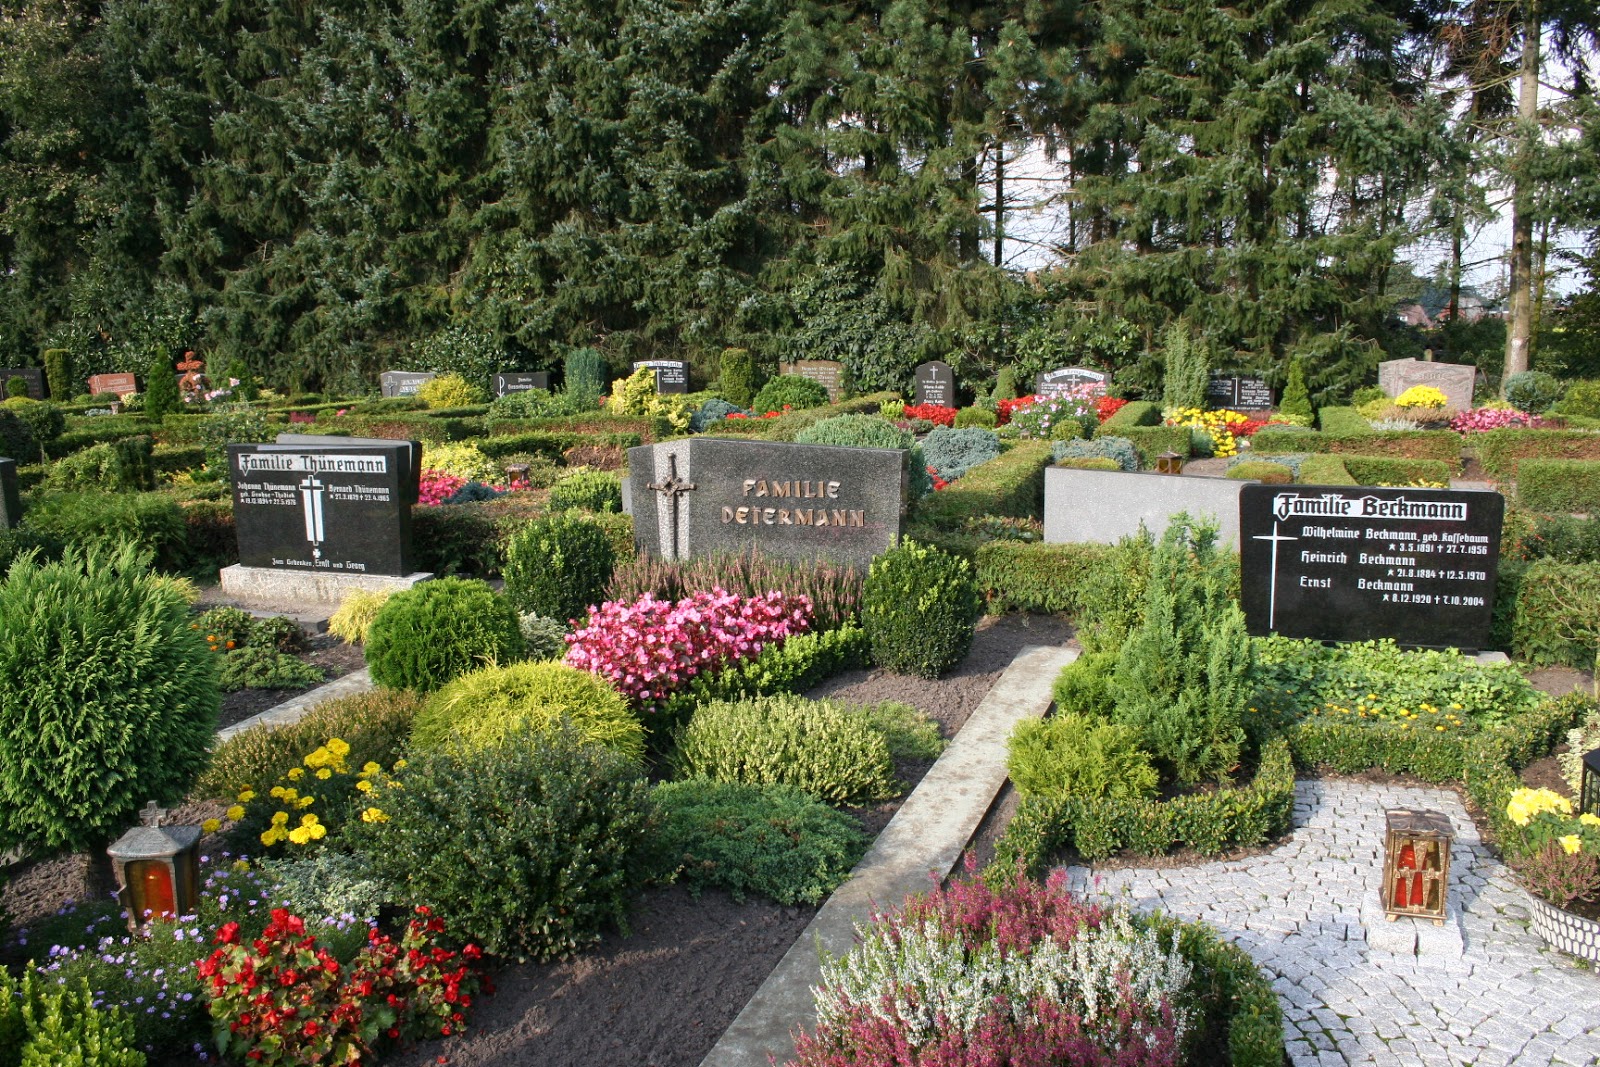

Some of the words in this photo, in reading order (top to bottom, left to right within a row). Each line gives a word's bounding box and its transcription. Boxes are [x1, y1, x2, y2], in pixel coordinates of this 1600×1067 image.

[240, 454, 293, 476] Familie
[300, 455, 385, 475] Thünemann
[742, 479, 841, 498] FAMILIE
[1277, 494, 1352, 520] Familie
[1361, 497, 1463, 519] Beckmann
[721, 505, 865, 527] DETERMANN
[1301, 526, 1360, 539] Wilhelmine
[1365, 528, 1420, 542] Beckmann,
[1422, 532, 1440, 543] geb.
[1399, 543, 1434, 552] 3.5.1891
[1446, 545, 1488, 555] 27.7.1956
[1301, 550, 1347, 564] Heinrich
[1358, 553, 1416, 566] Beckmann
[1447, 570, 1486, 580] 12.5.1970
[1300, 576, 1332, 588] Ernst
[1357, 578, 1414, 591] Beckmann
[1392, 593, 1431, 604] 8.12.1920
[1443, 595, 1485, 606] 7.10.2004
